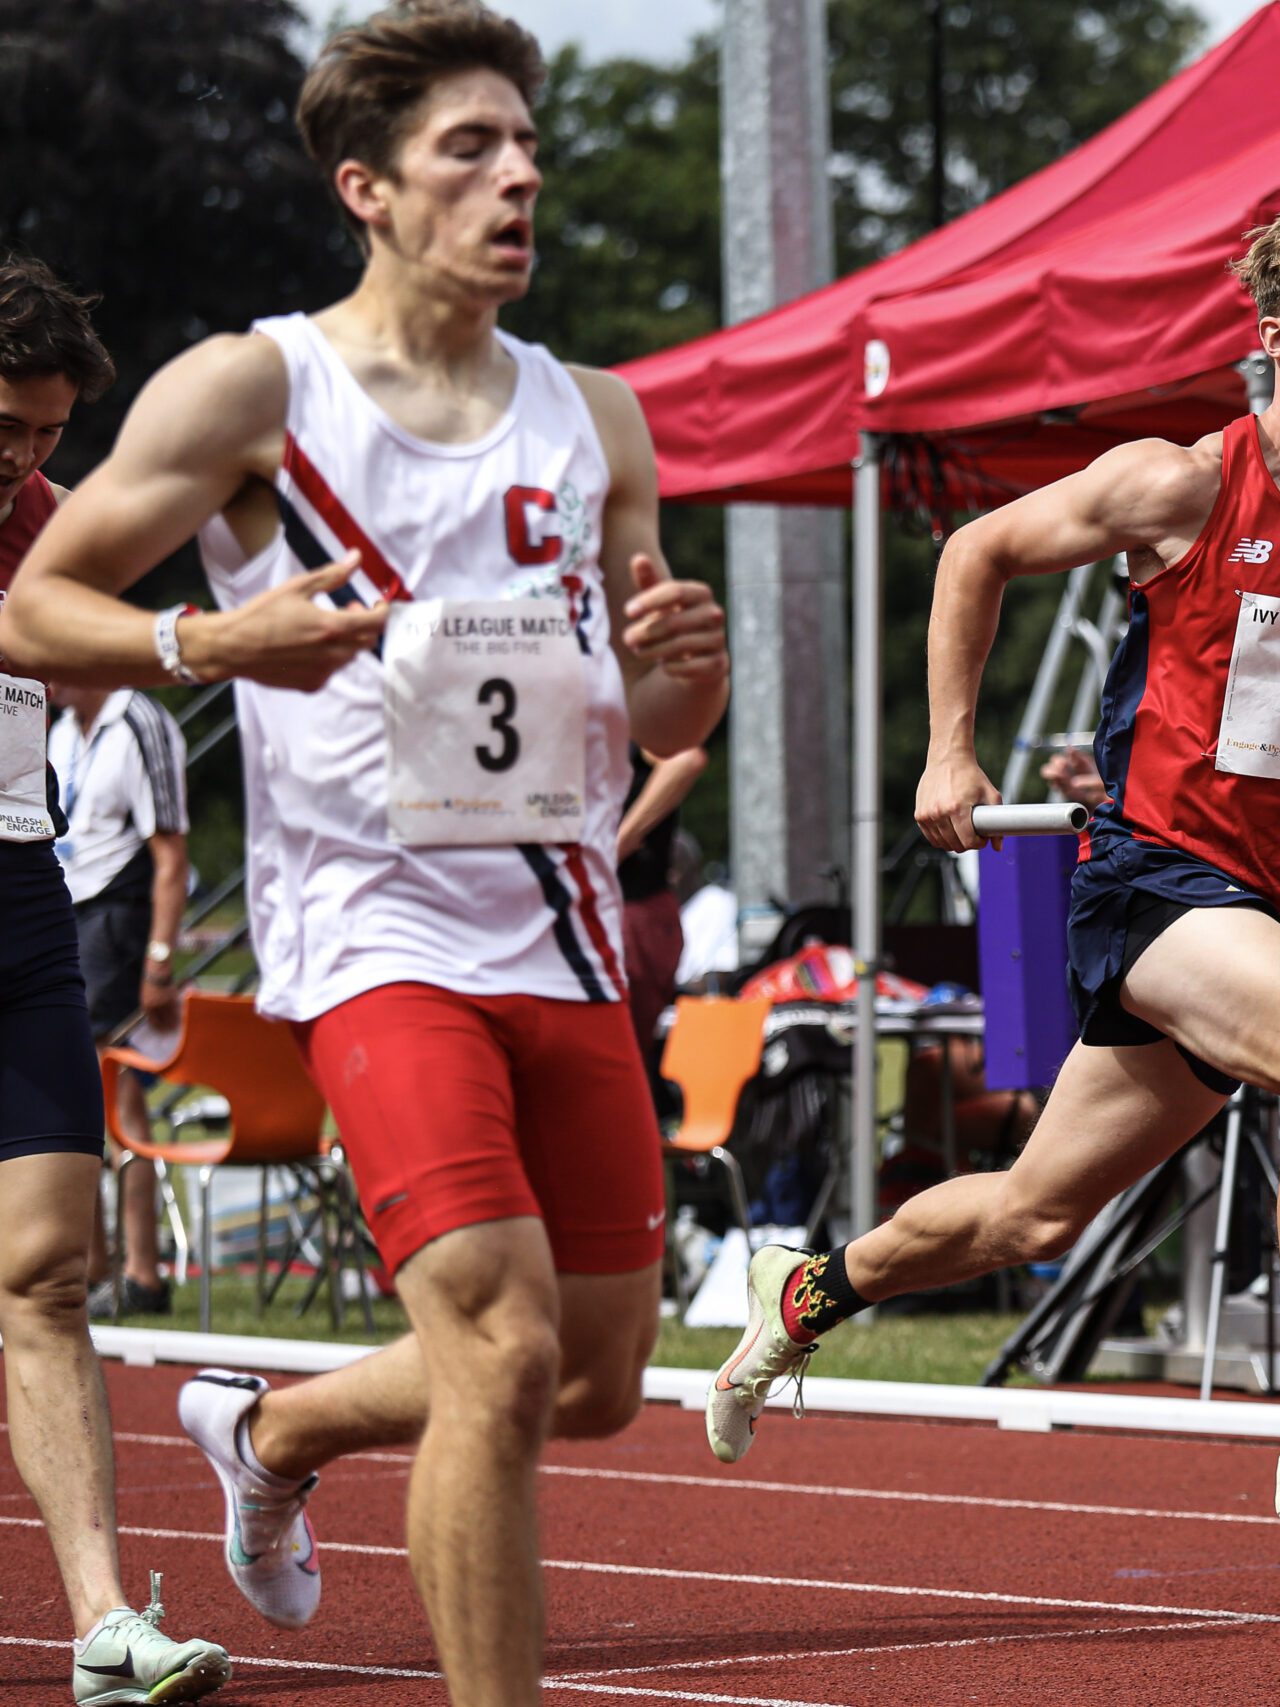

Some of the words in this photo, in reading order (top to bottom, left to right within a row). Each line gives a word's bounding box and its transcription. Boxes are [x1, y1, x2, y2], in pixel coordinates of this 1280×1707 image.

[503, 485, 562, 567] C
[444, 616, 514, 638] LEAGUE
[521, 617, 569, 637] MATC
[1253, 608, 1279, 625] IVY
[455, 641, 480, 655] THE
[486, 641, 509, 656] BIG
[5, 686, 43, 710] MATCH
[475, 677, 521, 773] 3
[6, 822, 52, 836] ENGAGE
